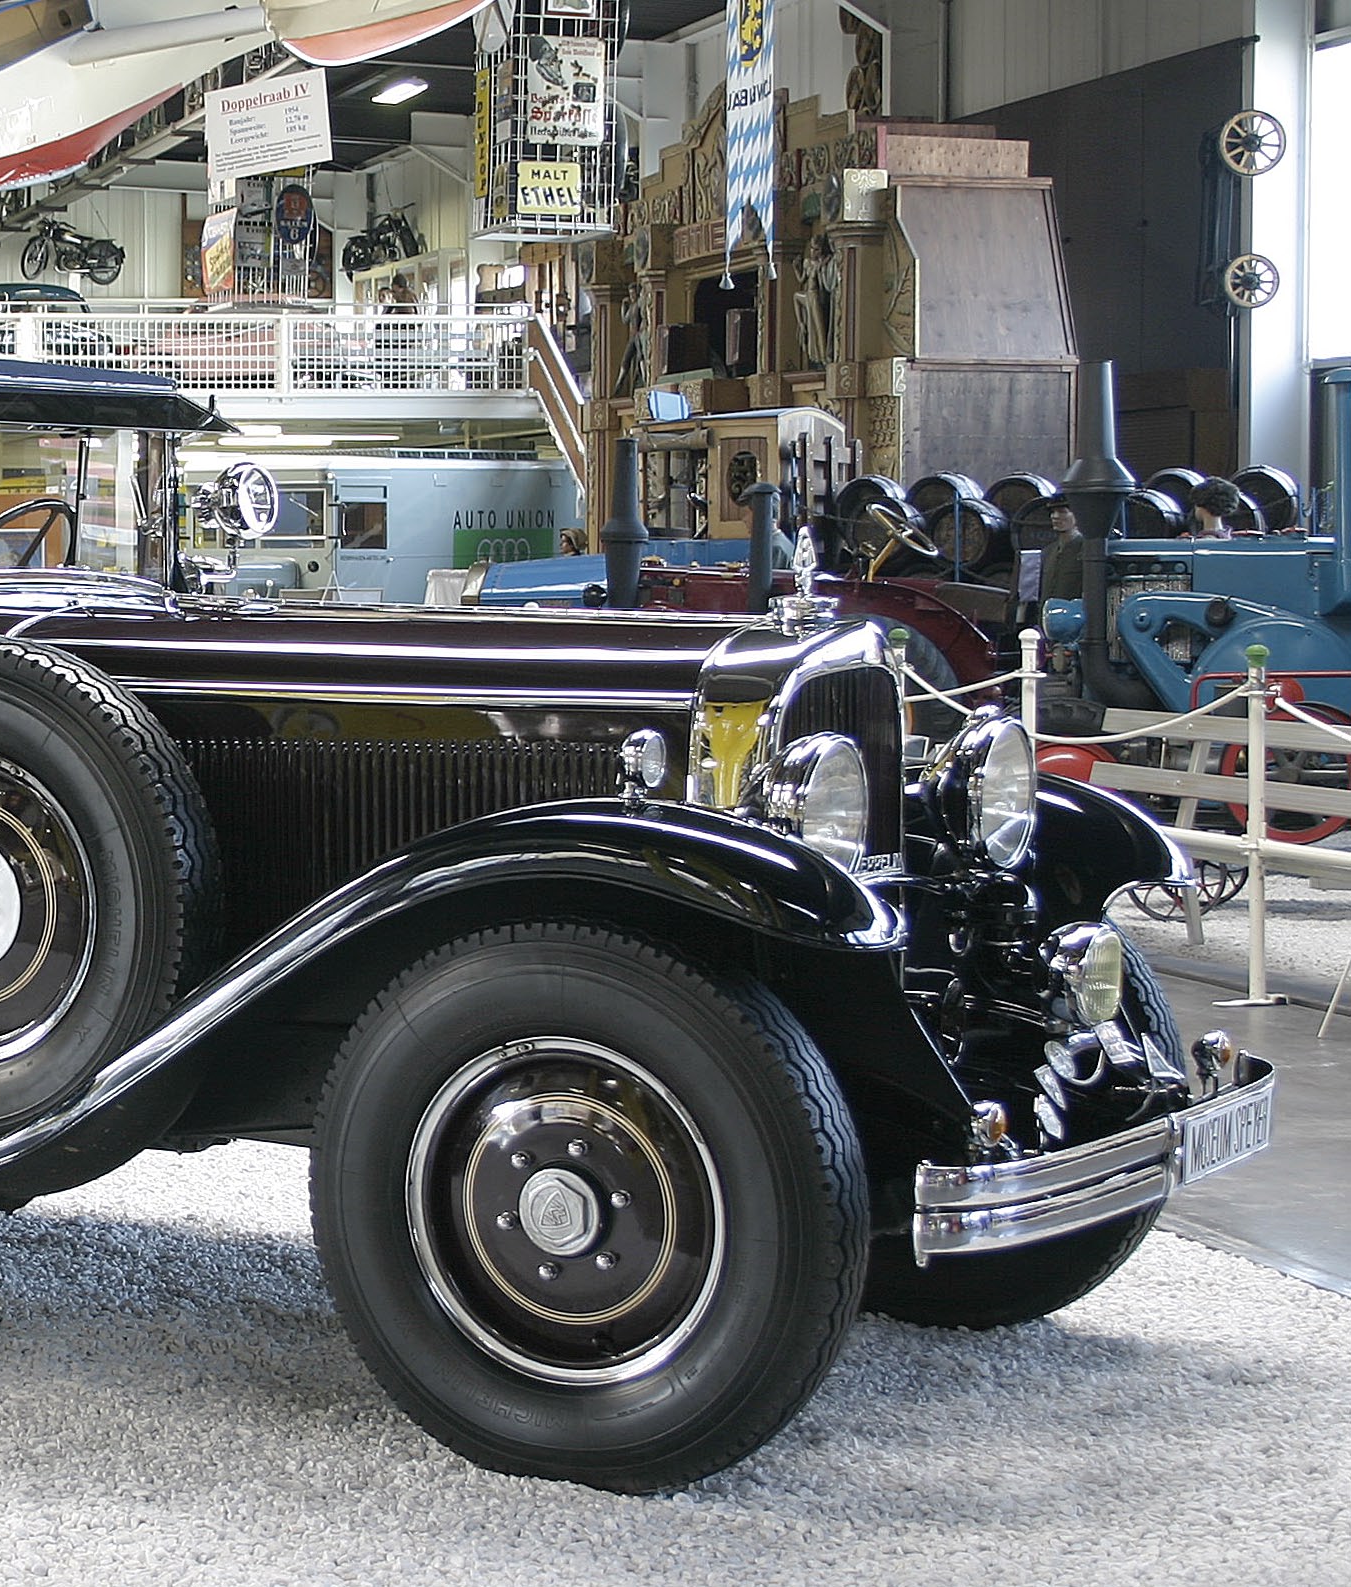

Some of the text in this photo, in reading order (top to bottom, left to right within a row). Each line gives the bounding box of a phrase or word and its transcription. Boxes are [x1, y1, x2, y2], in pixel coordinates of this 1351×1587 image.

[221, 82, 309, 112] Doppelraab IV
[476, 101, 487, 191] DUNLOP
[531, 169, 569, 181] MALT
[520, 185, 578, 207] ETHEL
[453, 510, 555, 529] AUTO UNION
[99, 850, 123, 997] MICHELIN
[1190, 1096, 1269, 1174] MUSEUM SPEYER
